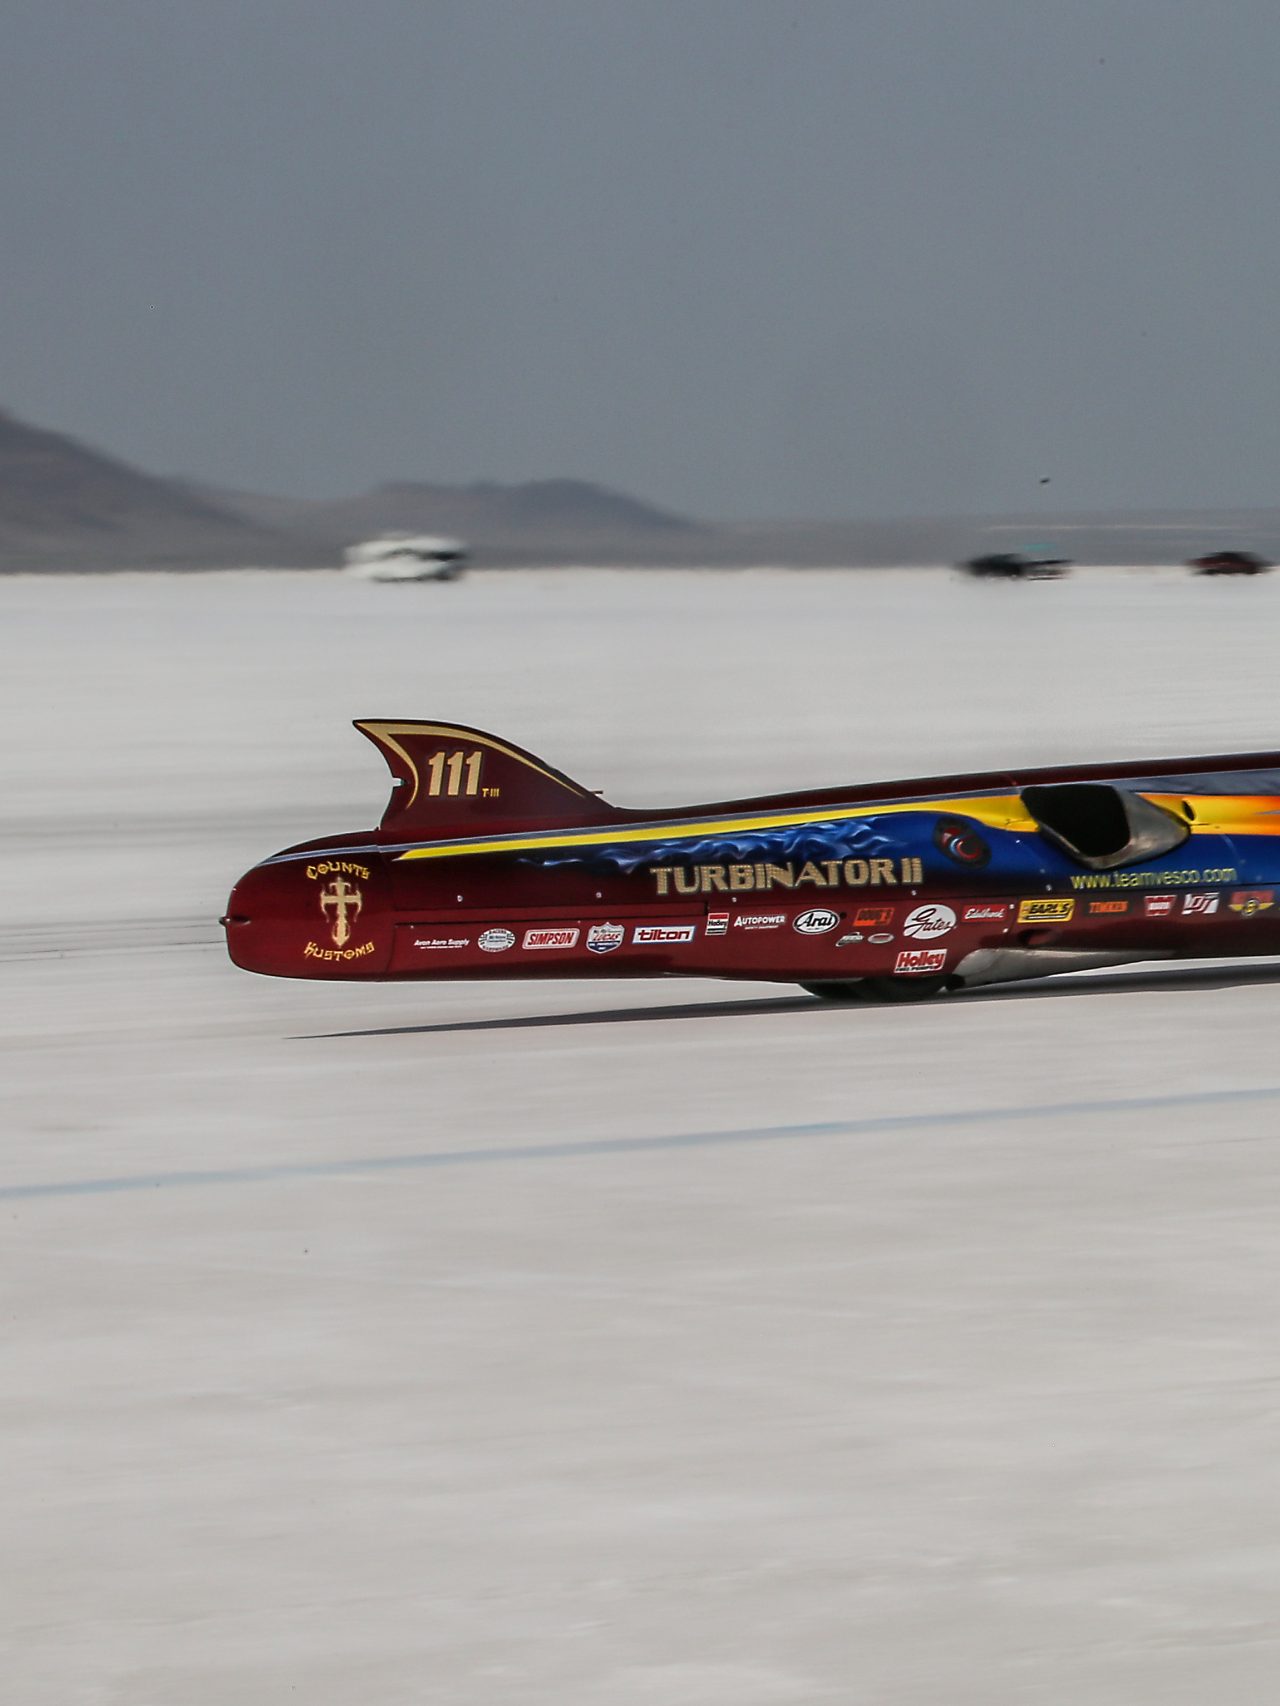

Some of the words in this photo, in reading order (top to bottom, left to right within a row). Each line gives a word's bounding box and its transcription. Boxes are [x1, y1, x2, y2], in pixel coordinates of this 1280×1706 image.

[428, 751, 482, 796] 111
[650, 859, 898, 895] TURBINATOR
[901, 857, 922, 884] II
[1070, 867, 1237, 889] www.teamvesco.com
[733, 915, 785, 927] AUTOPOWER
[797, 912, 835, 928] Arai
[903, 908, 955, 937] Gates
[527, 932, 574, 945] SIMPSON
[638, 929, 690, 941] tilton
[898, 952, 945, 969] Holley
